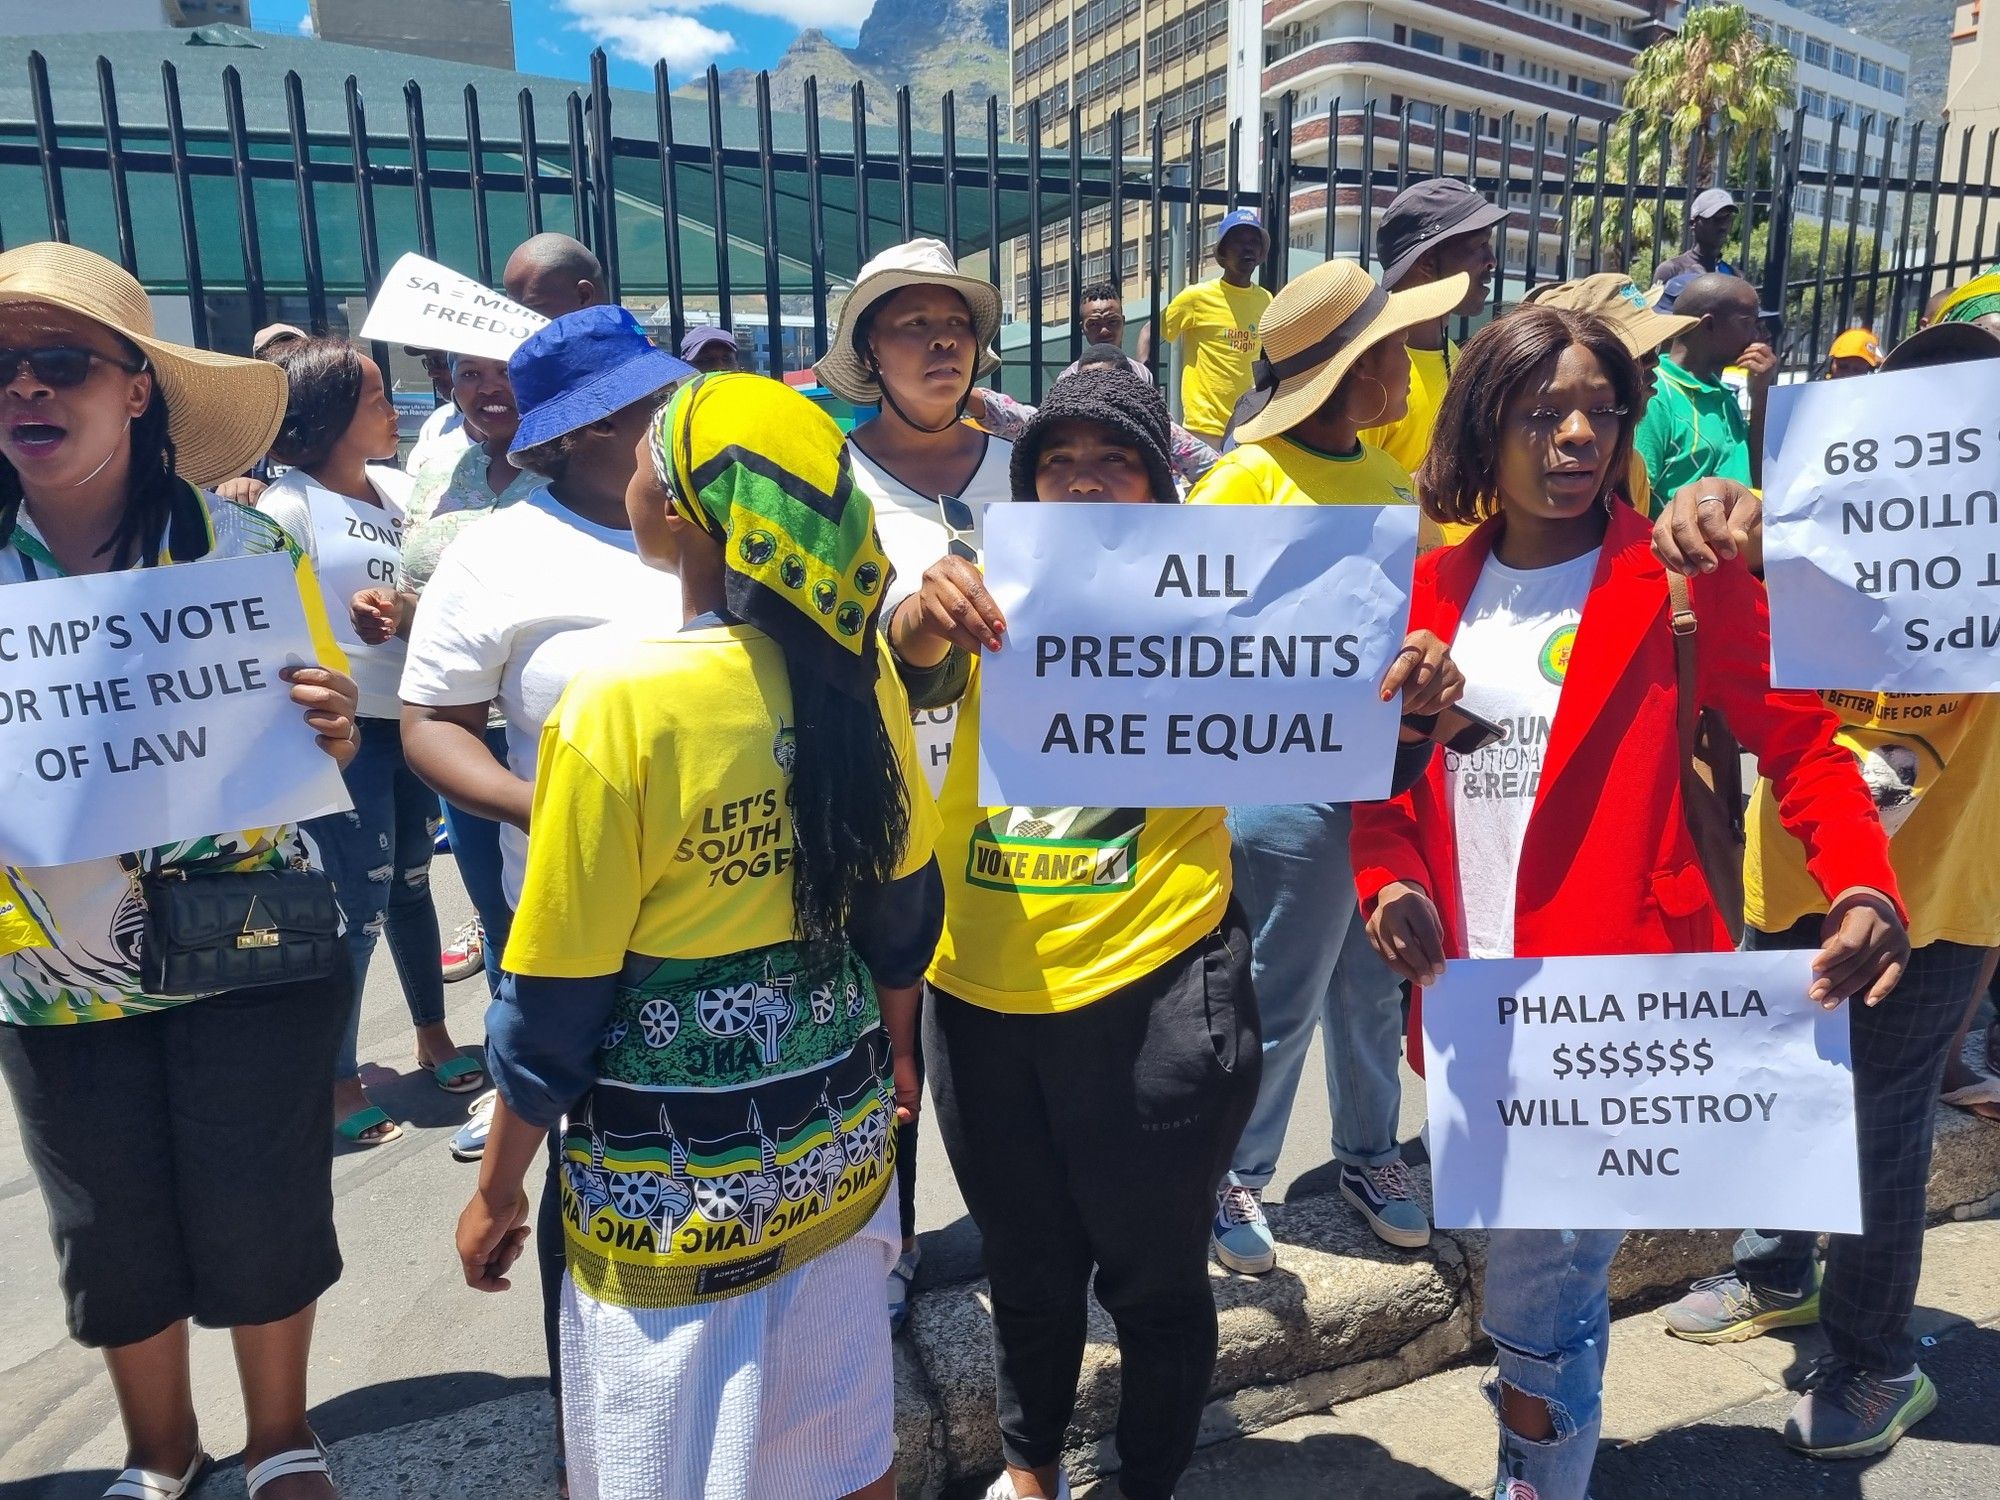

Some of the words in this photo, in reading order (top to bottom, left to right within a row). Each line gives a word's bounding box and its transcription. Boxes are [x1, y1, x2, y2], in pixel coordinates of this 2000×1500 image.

[405, 276, 441, 295] SA
[473, 294, 548, 324] MUR
[422, 303, 536, 340] FREEDO
[1824, 438, 1880, 476] 89
[1894, 428, 1983, 470] SEC
[1842, 490, 1999, 536] UTION
[366, 558, 395, 584] CR
[1154, 554, 1248, 598] ALL
[1854, 555, 1962, 594] OUR
[28, 614, 133, 659] MP'S
[140, 596, 271, 644] VOTE
[1036, 635, 1360, 679] PRESIDENTS
[48, 676, 137, 718] THE
[146, 658, 267, 706] RULE
[1828, 690, 1875, 714] BETTER
[1876, 703, 1898, 720] LIFE
[1903, 705, 1932, 719] FOR
[1041, 713, 1148, 755] ARE
[1167, 713, 1343, 762] EQUAL
[1494, 716, 1551, 747] OUN
[35, 745, 90, 782] OF
[103, 726, 207, 774] LAW
[702, 789, 777, 834] LET'S
[673, 817, 782, 865] SOUTH
[977, 846, 1029, 880] VOTE
[1031, 852, 1089, 881] ANC
[1497, 994, 1625, 1025] PHALA
[1637, 990, 1768, 1022] PHALA
[1552, 1037, 1714, 1080] $$$$$$$
[1496, 1098, 1589, 1127] WILL
[1600, 1092, 1778, 1126] DESTROY
[1597, 1147, 1680, 1176] ANC
